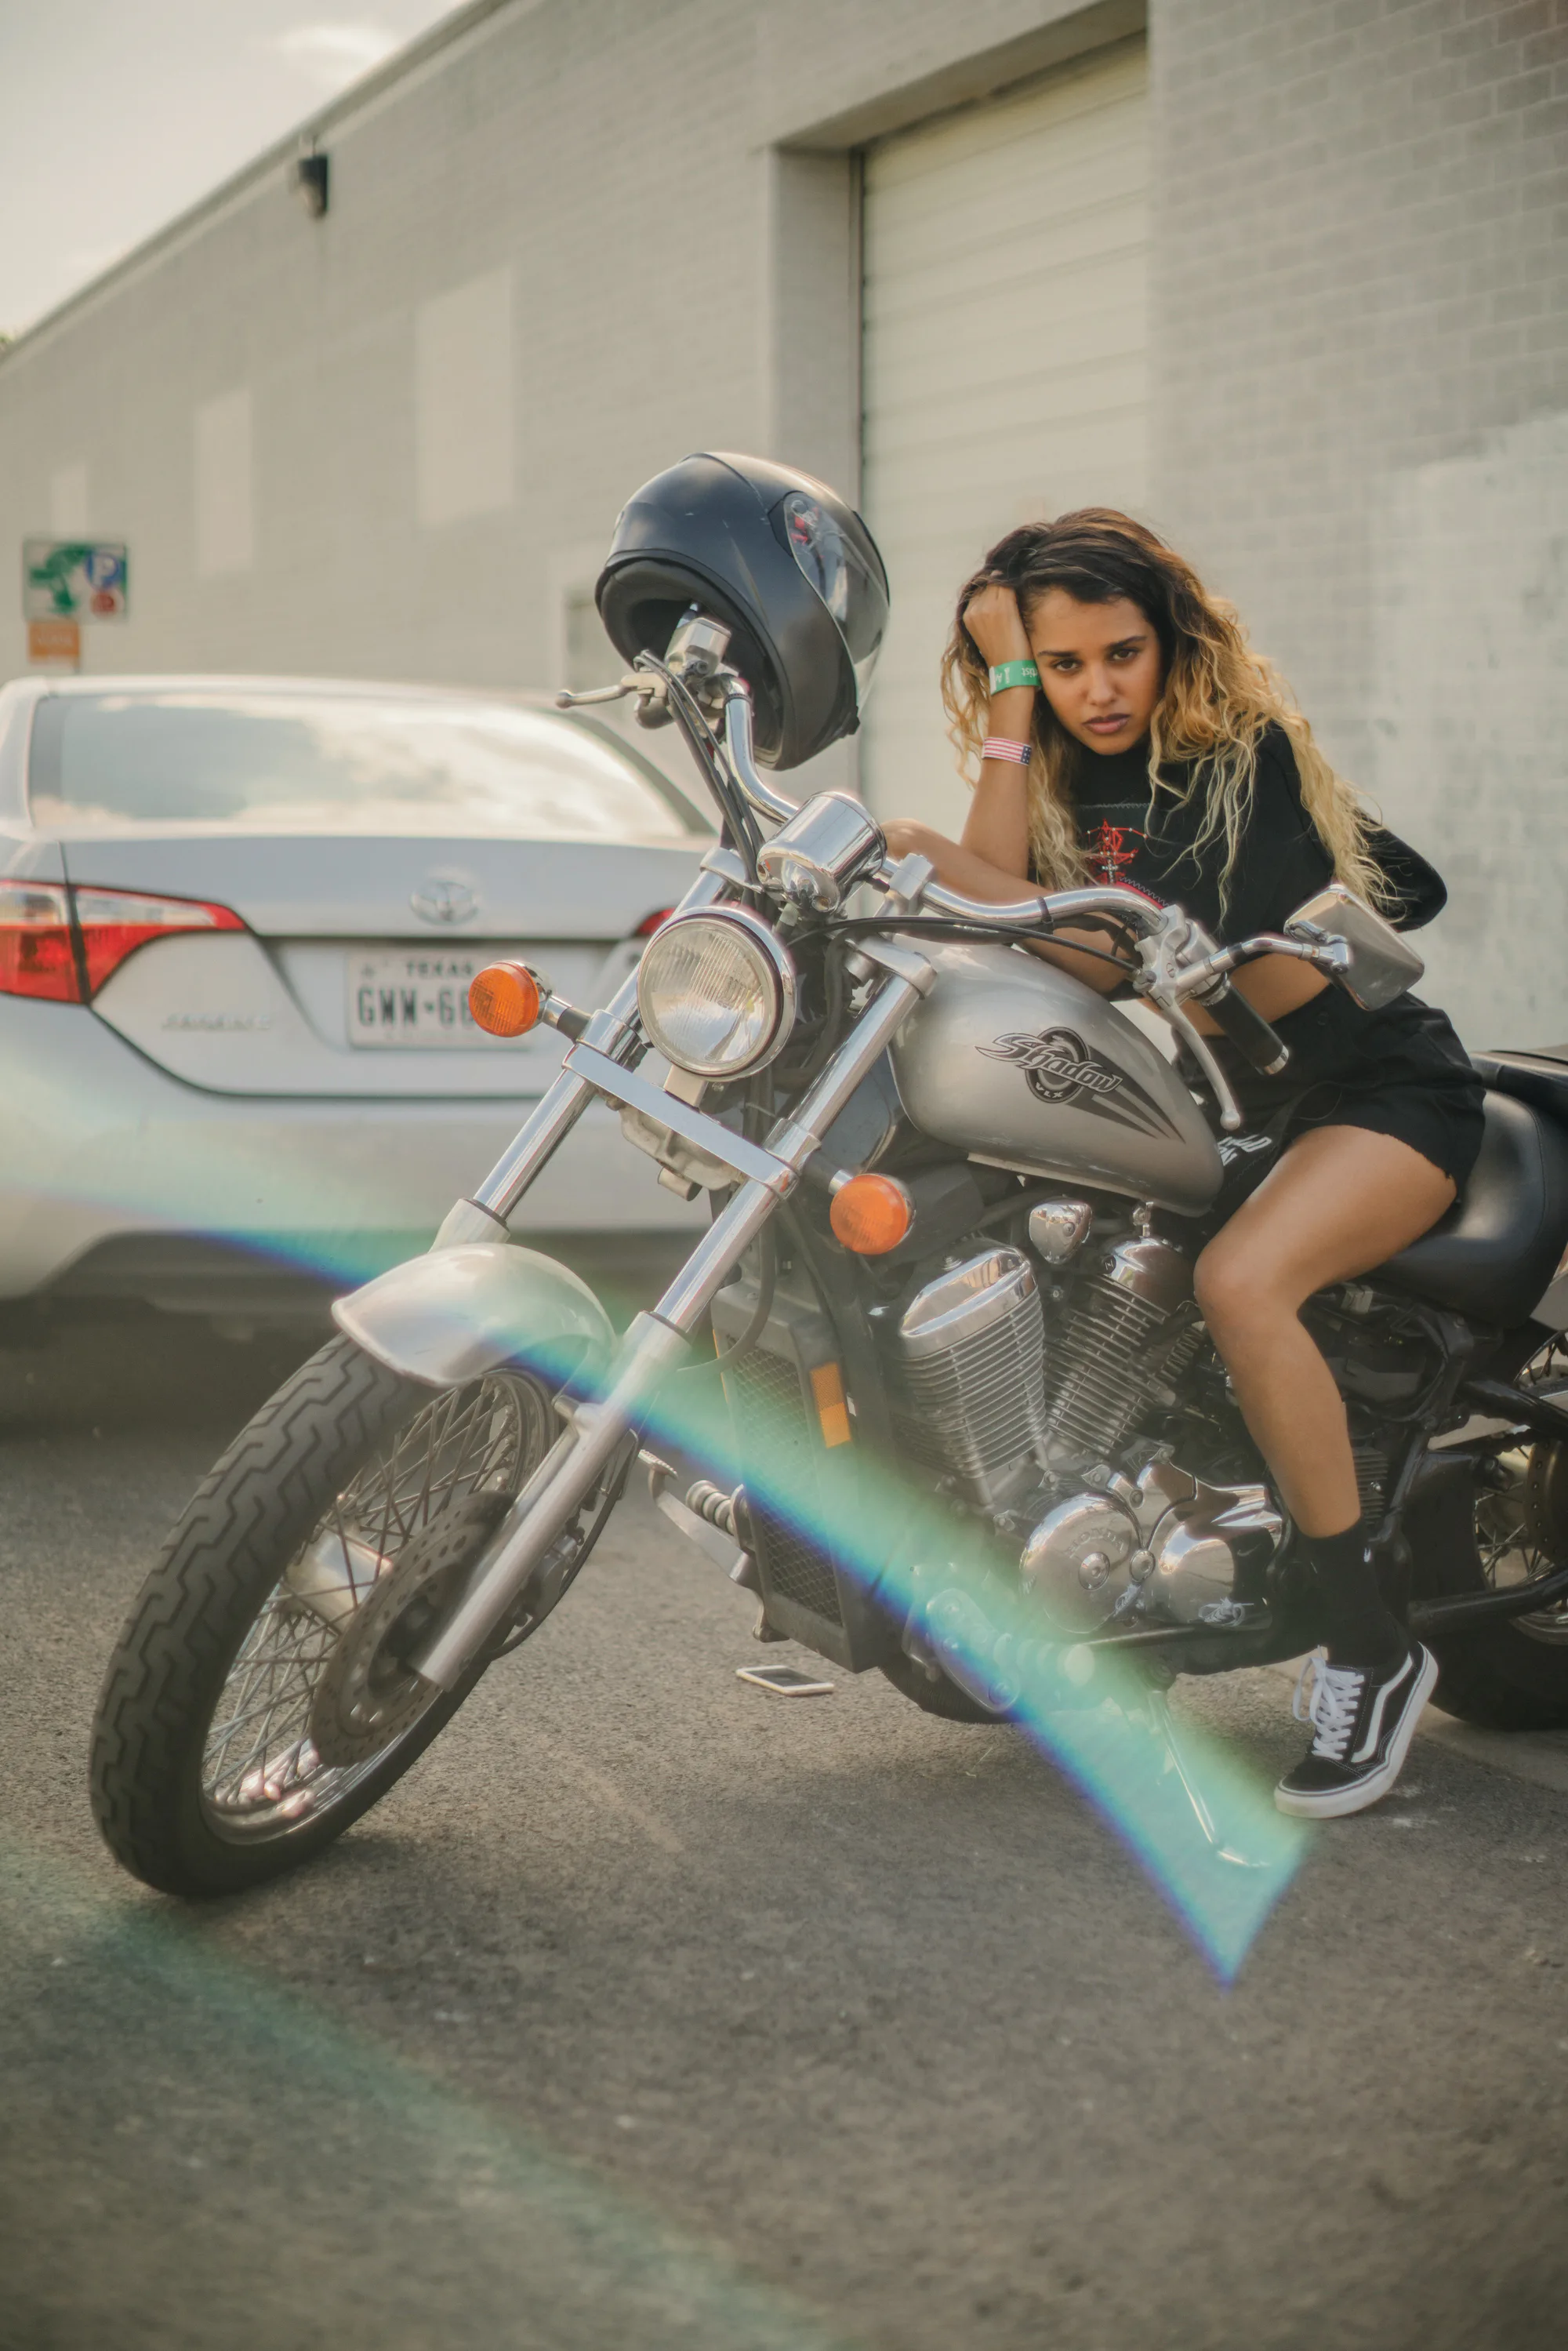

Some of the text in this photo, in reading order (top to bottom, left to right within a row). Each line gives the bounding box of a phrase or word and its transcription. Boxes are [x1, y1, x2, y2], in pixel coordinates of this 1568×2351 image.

[406, 960, 473, 978] TEXAS
[975, 1033, 1123, 1092] Shadow
[1035, 1082, 1064, 1099] VLX
[1066, 1527, 1124, 1559] HONDA
